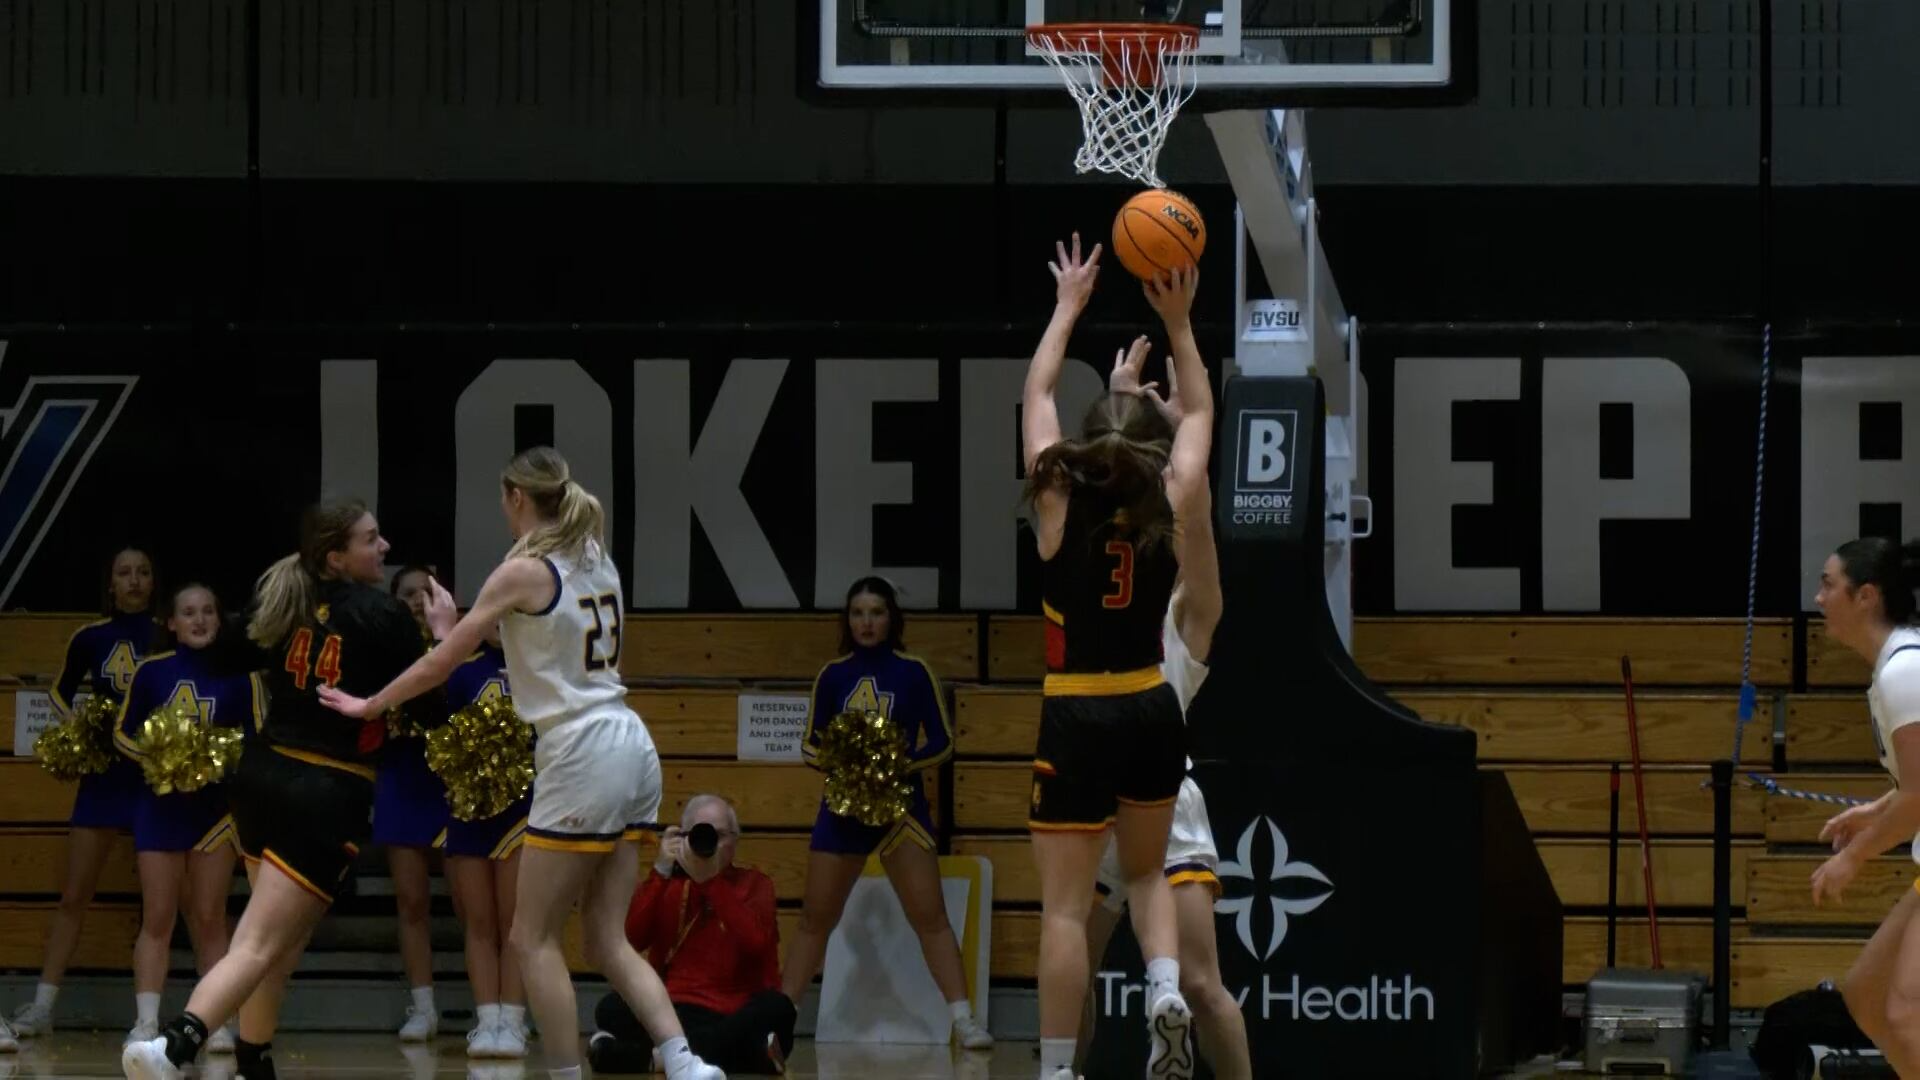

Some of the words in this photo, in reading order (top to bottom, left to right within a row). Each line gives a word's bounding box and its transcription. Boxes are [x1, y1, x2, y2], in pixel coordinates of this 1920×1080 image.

[1162, 205, 1200, 240] NCAA
[1251, 311, 1300, 327] GVSU
[1247, 419, 1286, 482] B
[1232, 513, 1292, 524] COFFEE
[1102, 541, 1134, 609] 3
[578, 592, 621, 672] 23
[285, 627, 342, 690] 44
[752, 703, 807, 712] RESERVED
[750, 716, 770, 725] FOR
[749, 730, 771, 738] AND
[773, 731, 806, 739] CHEE
[764, 743, 793, 753] TEAM
[1096, 971, 1250, 1017] Triy
[1262, 974, 1435, 1021] Health
